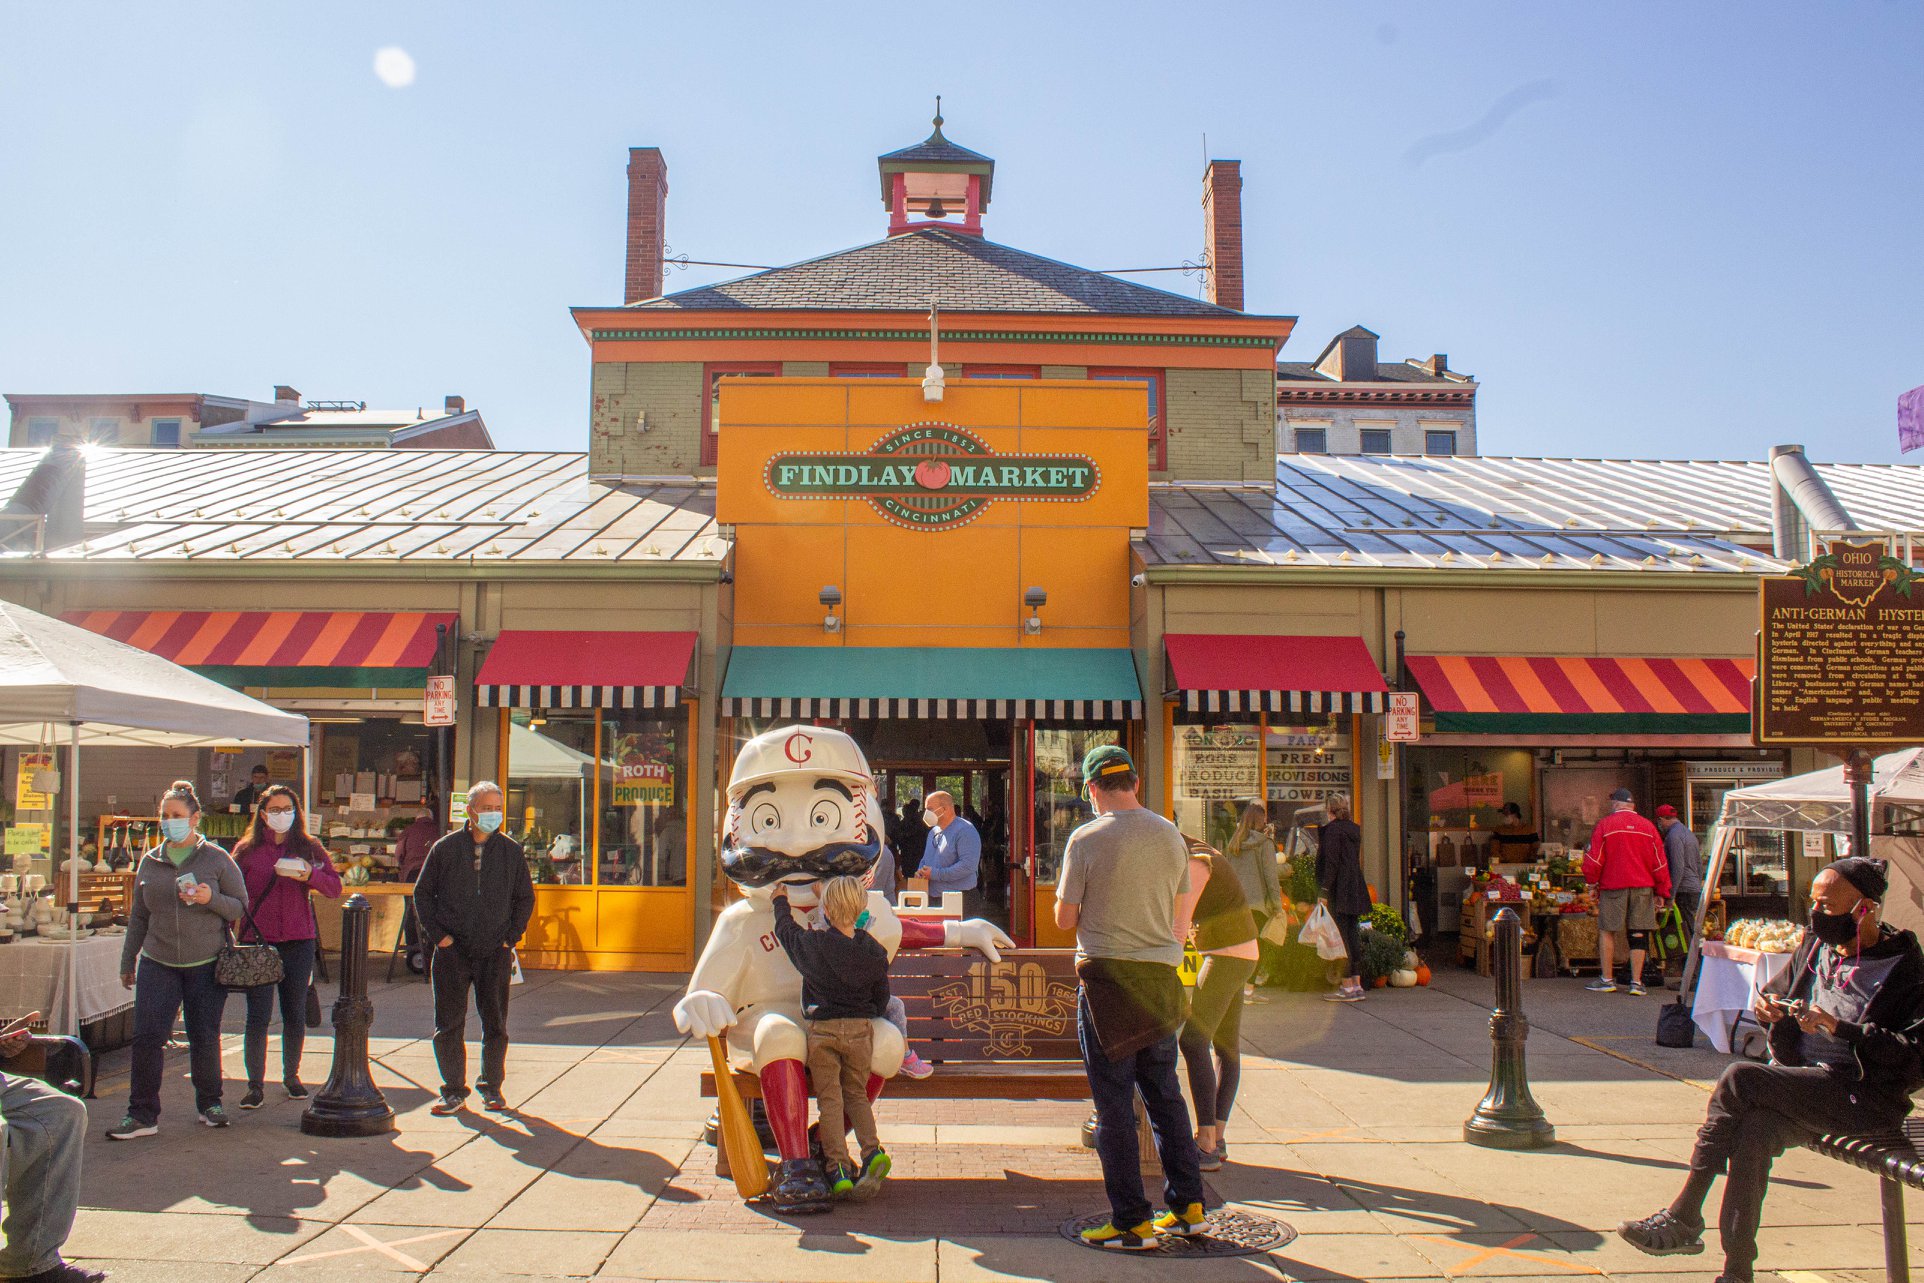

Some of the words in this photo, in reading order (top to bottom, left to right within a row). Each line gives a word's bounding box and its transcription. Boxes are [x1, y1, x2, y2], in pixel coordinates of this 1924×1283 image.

[886, 430, 933, 452] SINCE
[943, 431, 976, 453] 1852
[778, 465, 916, 487] FINDLAY
[948, 466, 1089, 488] MARKET
[885, 499, 977, 523] CINCINNATI
[1843, 552, 1872, 565] OHIO
[1836, 570, 1880, 578] HISTORICAL
[1840, 579, 1874, 587] MARKER
[1771, 607, 1866, 620] ANTI-GERMAN
[1879, 609, 1924, 620] HYSTE
[1784, 631, 1801, 639] April
[1882, 632, 1902, 640] tragic
[433, 681, 445, 690] NO
[426, 690, 452, 700] PARKING
[1900, 689, 1920, 697] police
[1395, 697, 1407, 706] NO
[1794, 696, 1818, 704] English
[785, 733, 813, 763] C
[1280, 753, 1335, 764] FRESH
[623, 765, 665, 777] ROTH
[1267, 771, 1350, 782] PROVISIONS
[615, 786, 672, 802] PRODUCE
[1189, 788, 1237, 799] BASIL
[967, 961, 1046, 1013] 150
[939, 988, 962, 1000] EST.
[957, 1009, 983, 1024] RED
[993, 1011, 1062, 1032] STOCKINGS
